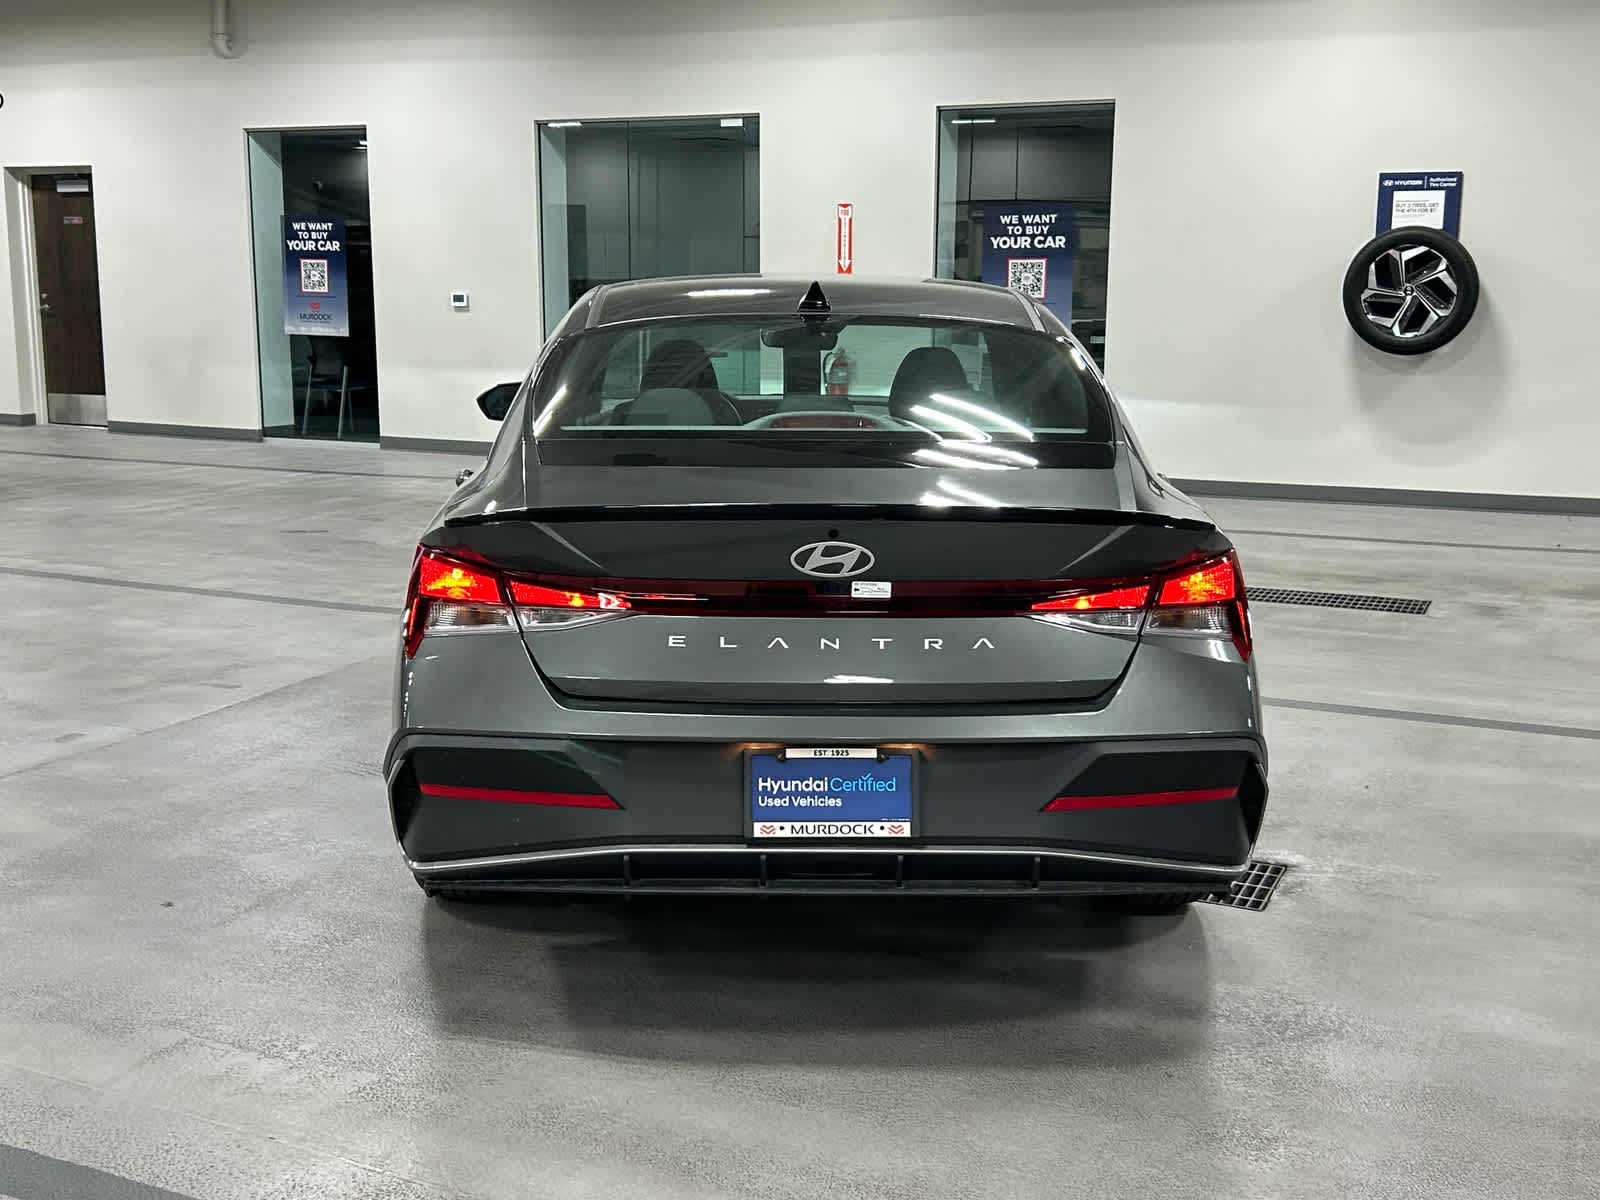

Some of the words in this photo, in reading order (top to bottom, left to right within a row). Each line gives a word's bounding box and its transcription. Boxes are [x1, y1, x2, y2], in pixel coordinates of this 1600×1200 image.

[1000, 215, 1019, 224] WE
[1022, 214, 1057, 224] WANT
[292, 222, 306, 230] WE
[308, 222, 333, 231] WANT
[1007, 226, 1022, 235] TO
[1025, 225, 1049, 234] BUY
[297, 231, 309, 239] TO
[311, 231, 328, 240] BUY
[287, 240, 316, 251] YOUR
[317, 240, 340, 251] CAR
[990, 236, 1031, 249] YOUR
[1034, 235, 1066, 248] CAR
[667, 635, 995, 650] ELANTRA
[758, 776, 828, 795] Hyundai
[830, 773, 896, 792] Certified
[758, 796, 789, 807] Used
[792, 795, 843, 807] Vehicles
[790, 824, 874, 835] MURDOCK
